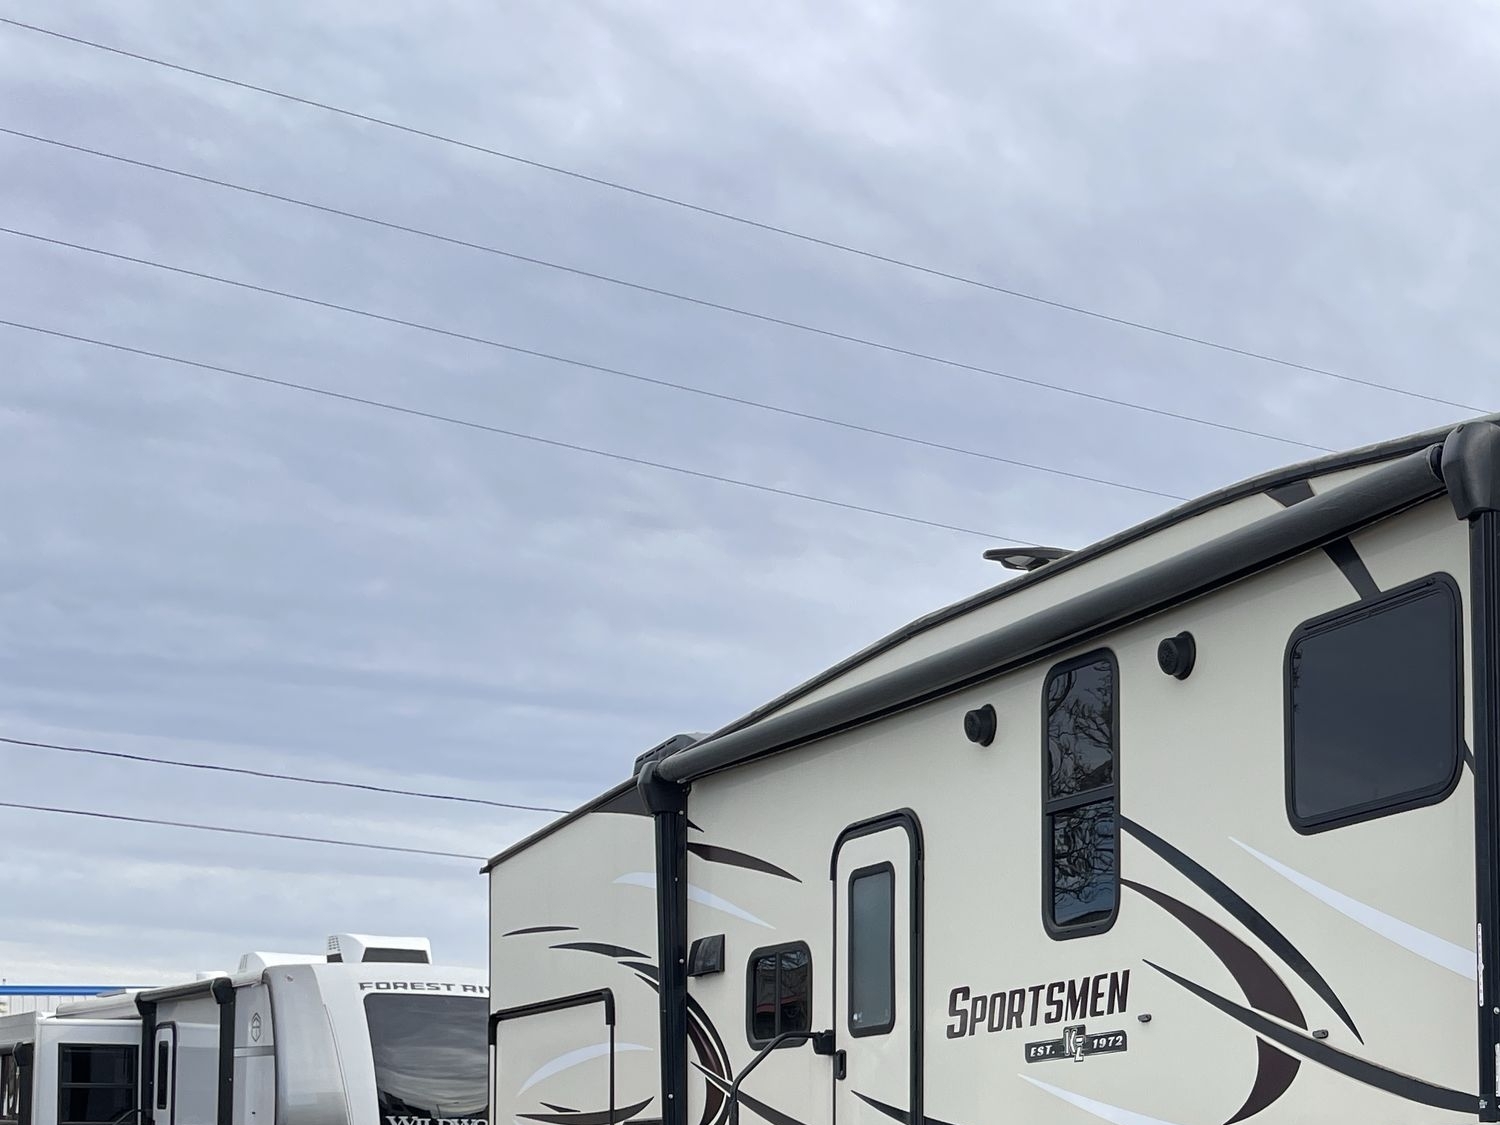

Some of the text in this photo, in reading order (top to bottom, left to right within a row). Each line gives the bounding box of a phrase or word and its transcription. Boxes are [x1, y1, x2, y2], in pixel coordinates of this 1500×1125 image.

[358, 982, 456, 992] FOREST
[946, 968, 1131, 1040] SPORTSMEN
[1030, 1045, 1056, 1057] EST.
[1092, 1035, 1123, 1049] 1972
